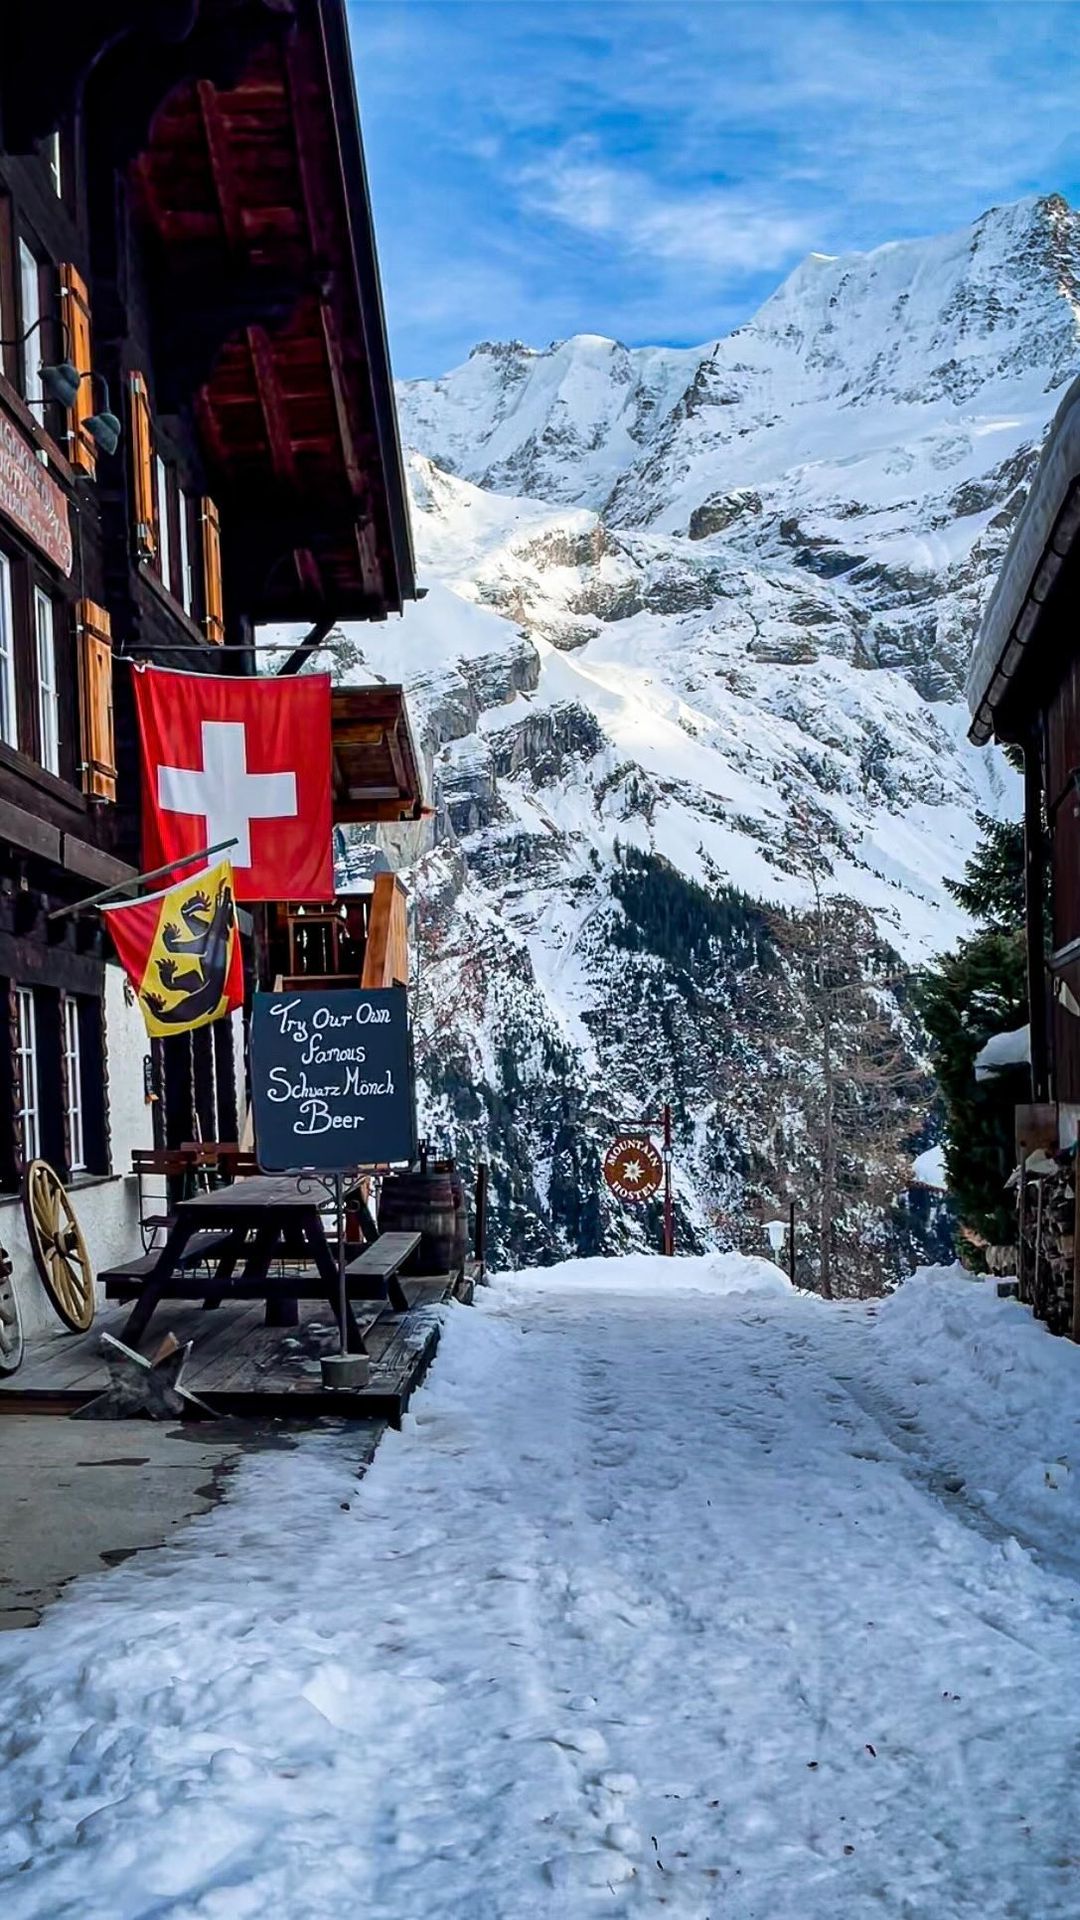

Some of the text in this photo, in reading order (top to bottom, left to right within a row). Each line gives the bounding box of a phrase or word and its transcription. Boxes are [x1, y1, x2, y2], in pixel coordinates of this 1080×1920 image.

[270, 999, 391, 1042] Try Our Own
[267, 1066, 394, 1102] Schwarz Mönch
[293, 1099, 365, 1134] Beer
[607, 1139, 660, 1167] MOUNTAIN
[611, 1181, 656, 1200] HOSTEL
